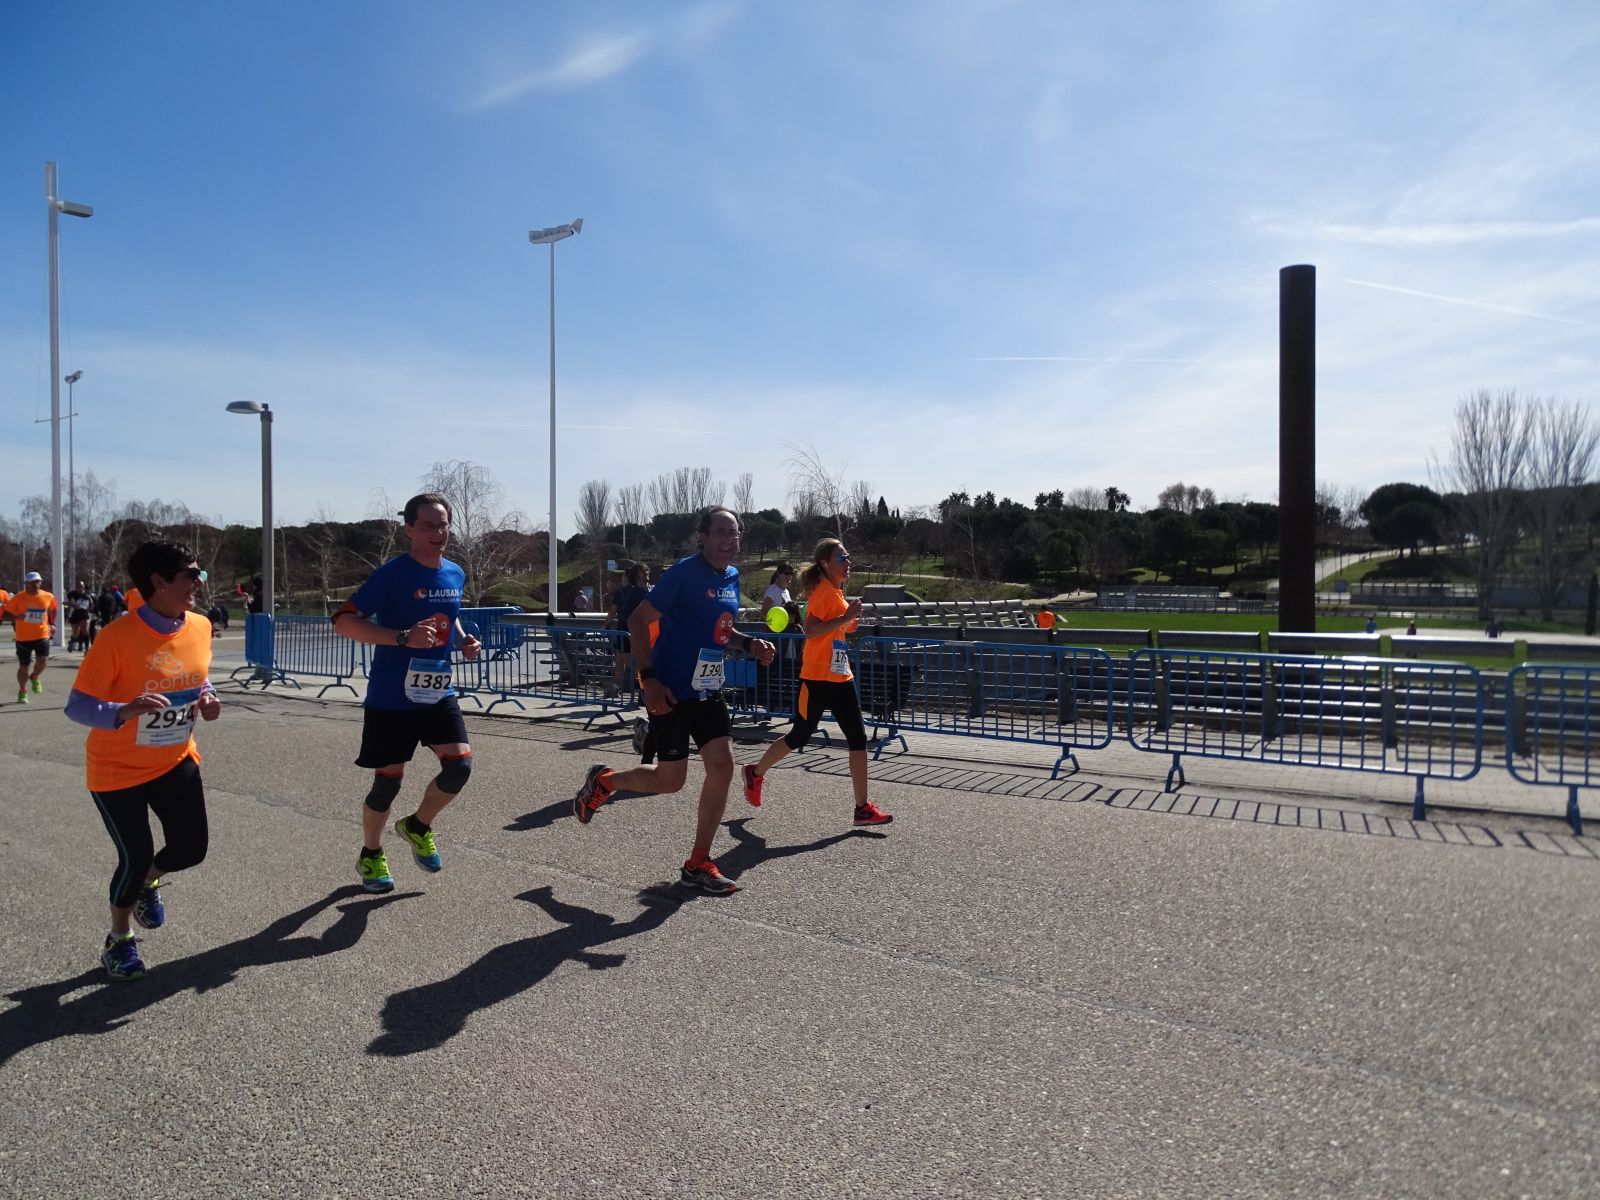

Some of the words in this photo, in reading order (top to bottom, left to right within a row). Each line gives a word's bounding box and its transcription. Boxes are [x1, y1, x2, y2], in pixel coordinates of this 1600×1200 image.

[145, 671, 202, 692] ponte
[411, 673, 452, 689] 1382
[146, 704, 195, 729] 2914
